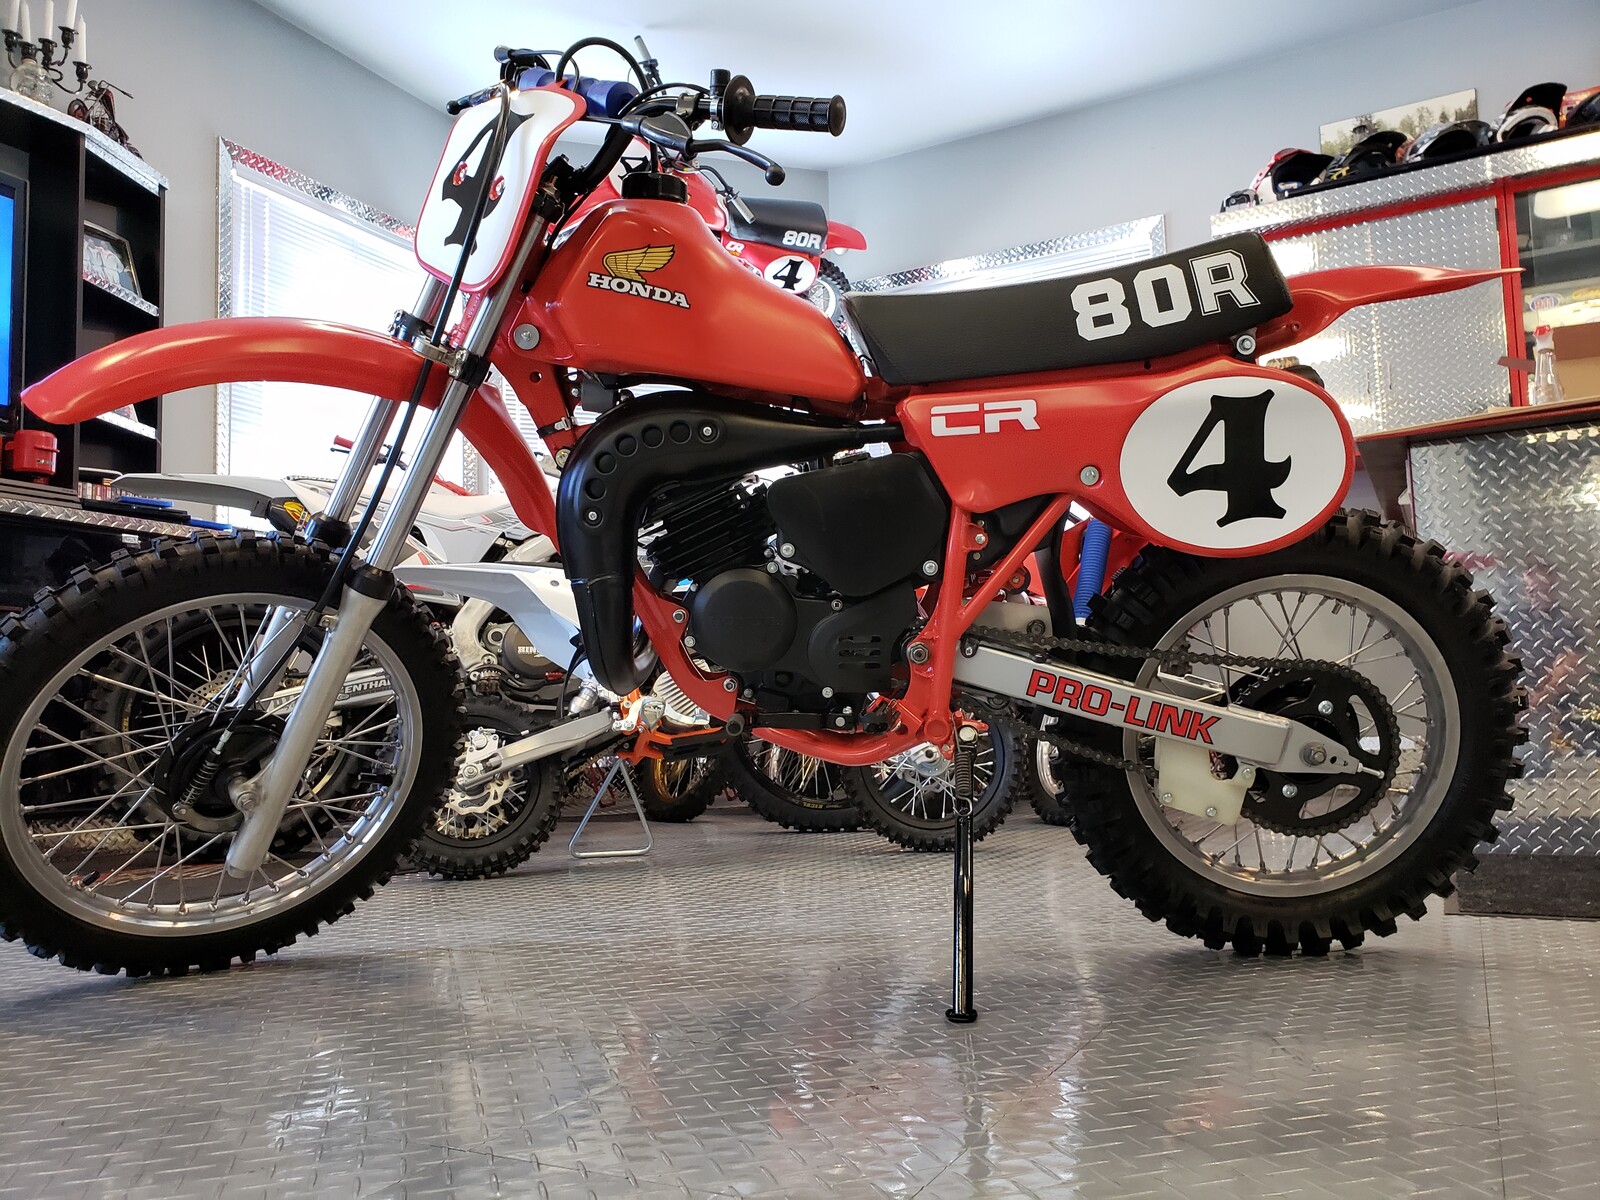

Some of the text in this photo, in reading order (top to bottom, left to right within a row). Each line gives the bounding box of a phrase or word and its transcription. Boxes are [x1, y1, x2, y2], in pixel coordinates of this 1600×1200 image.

[726, 240, 745, 253] CR
[782, 230, 822, 249] 80R
[587, 271, 691, 309] HONDA
[772, 258, 804, 291] 4
[1070, 249, 1261, 341] 80R
[931, 399, 1041, 437] CR
[1167, 389, 1292, 528] 4
[1026, 669, 1222, 745] PRO-LINK
